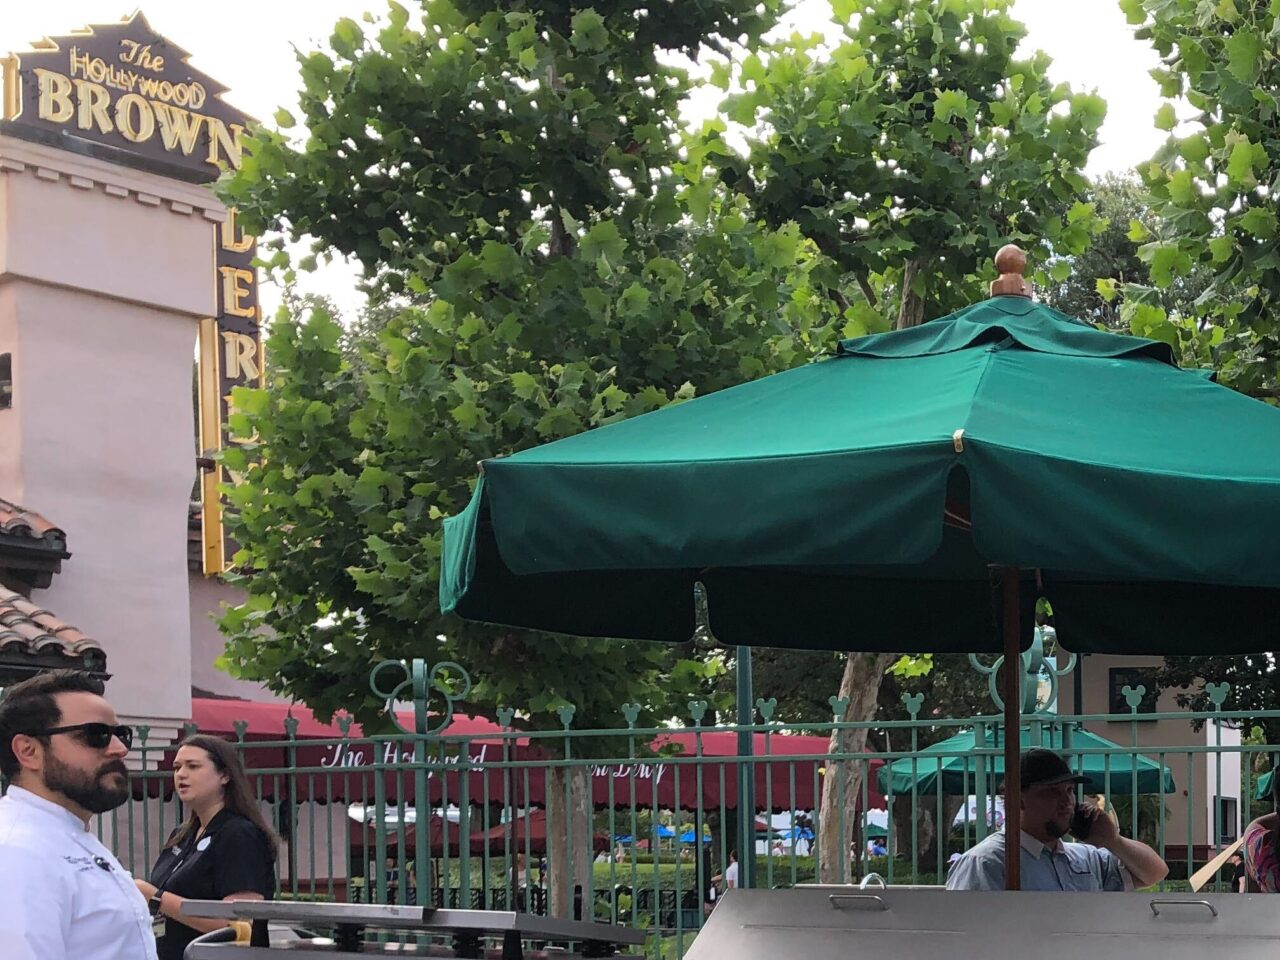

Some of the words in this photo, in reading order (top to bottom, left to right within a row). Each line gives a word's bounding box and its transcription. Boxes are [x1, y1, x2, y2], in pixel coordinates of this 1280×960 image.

[69, 45, 206, 109] HOLLYWOOD
[119, 39, 165, 72] The
[35, 67, 245, 172] BROWN
